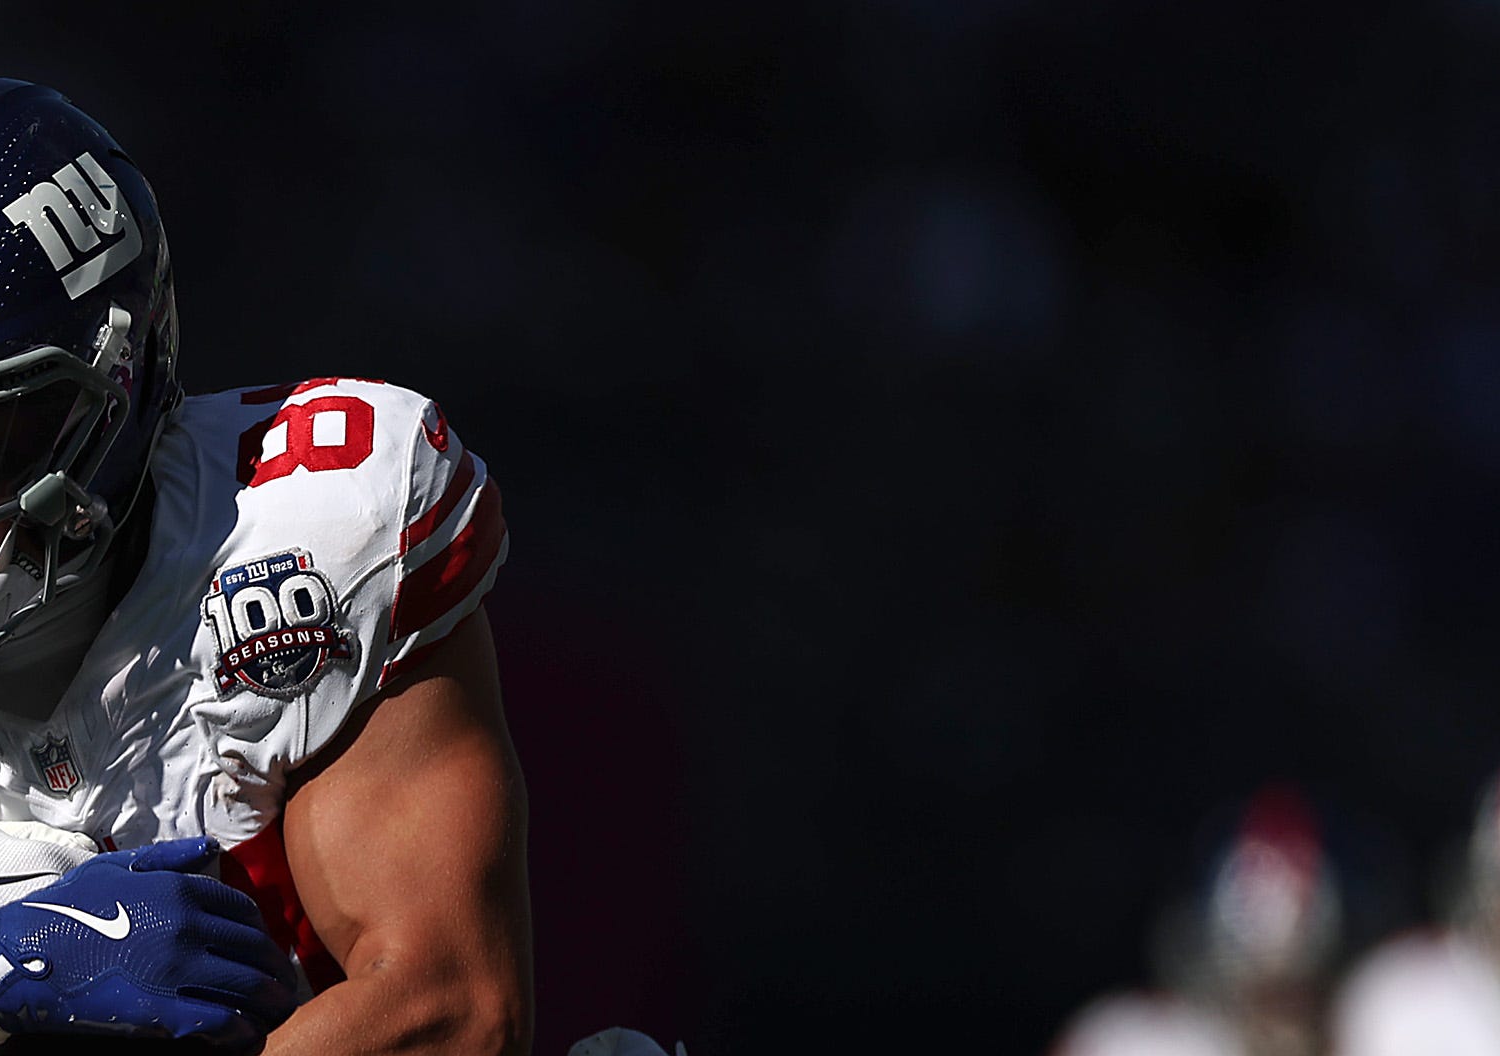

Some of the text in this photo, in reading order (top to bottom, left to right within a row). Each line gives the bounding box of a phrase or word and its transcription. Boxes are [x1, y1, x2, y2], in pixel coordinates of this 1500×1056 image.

[237, 376, 386, 487] 8
[269, 559, 294, 574] 1925
[207, 574, 331, 654] 100
[228, 629, 326, 667] SEASONS
[45, 762, 77, 789] NFL
